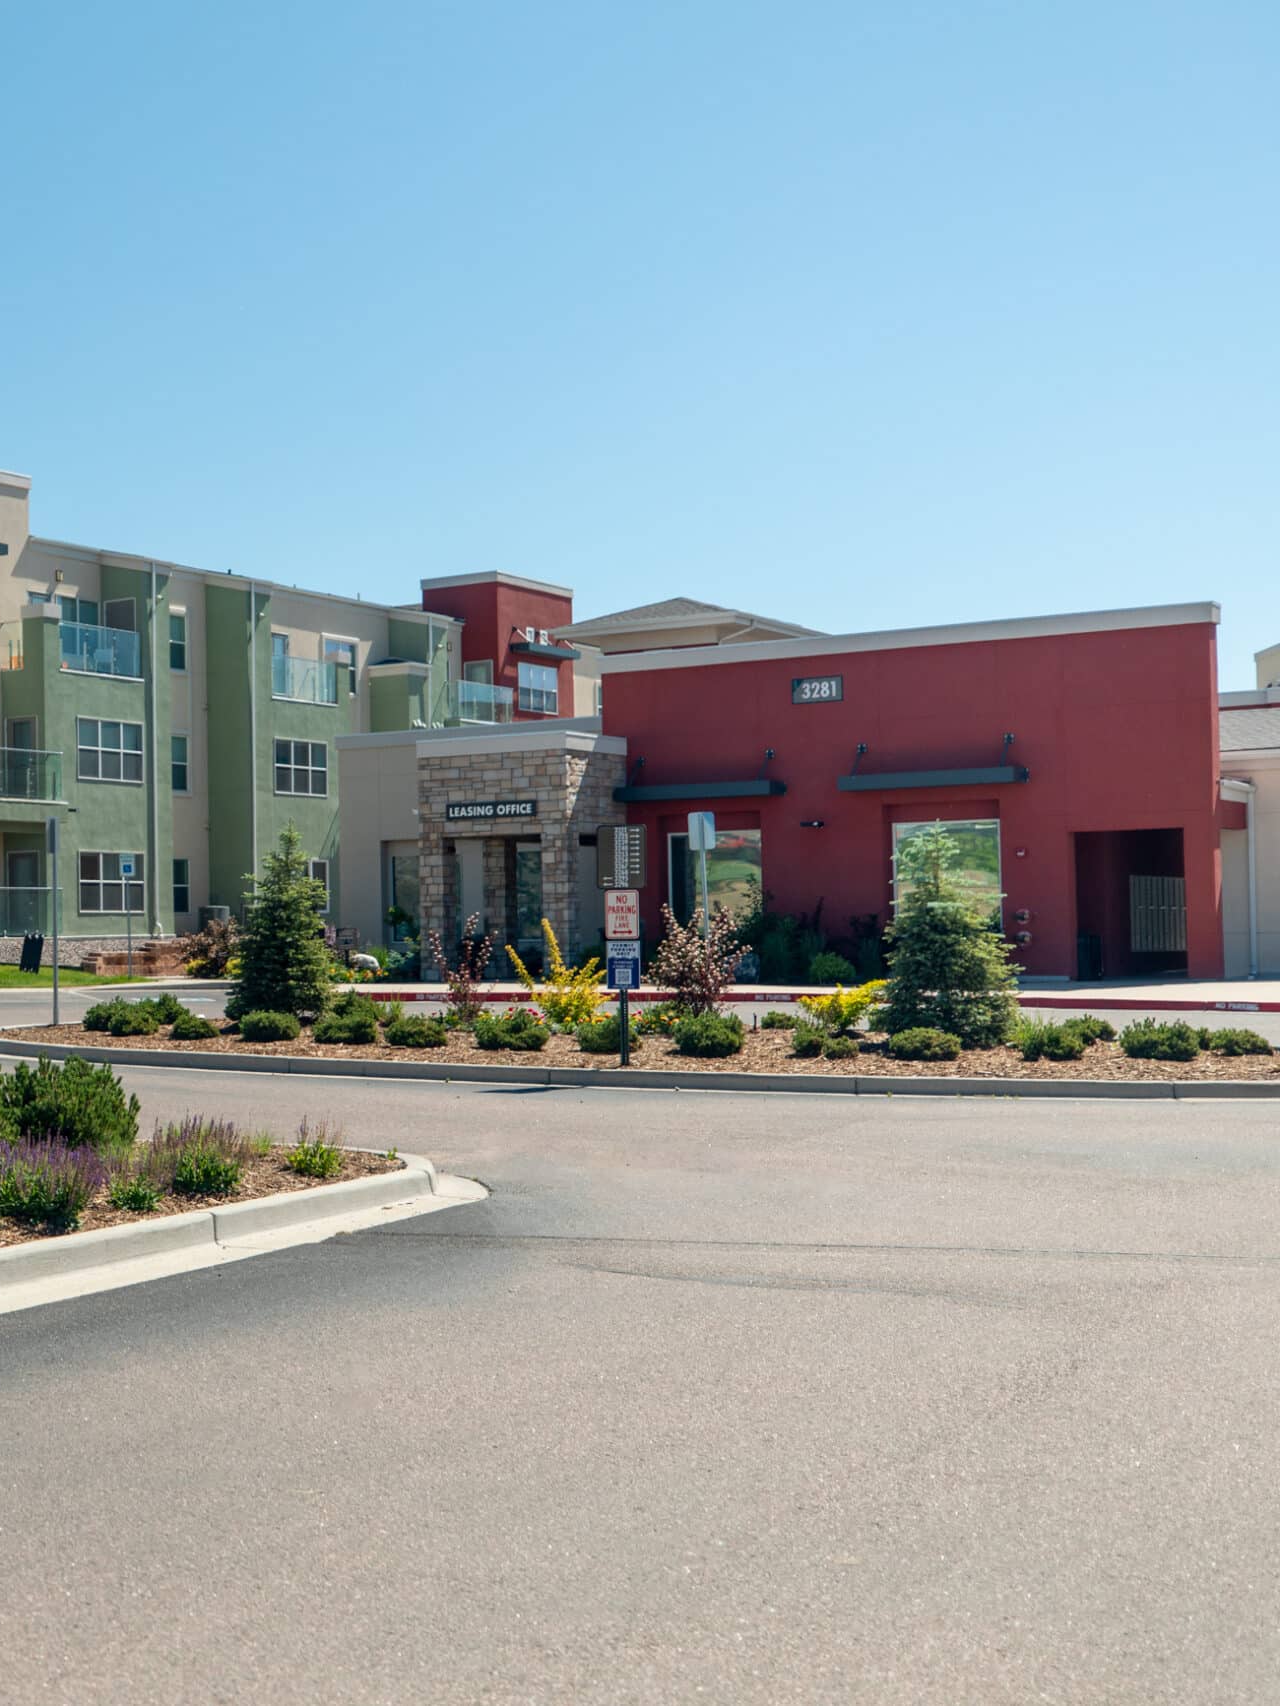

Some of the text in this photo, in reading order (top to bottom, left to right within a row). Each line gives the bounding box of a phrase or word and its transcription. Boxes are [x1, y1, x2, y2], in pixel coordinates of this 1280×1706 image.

[801, 681, 837, 699] 3281
[449, 803, 533, 818] LEASING OFFICE
[616, 895, 627, 904] NO
[607, 905, 637, 914] PARKING
